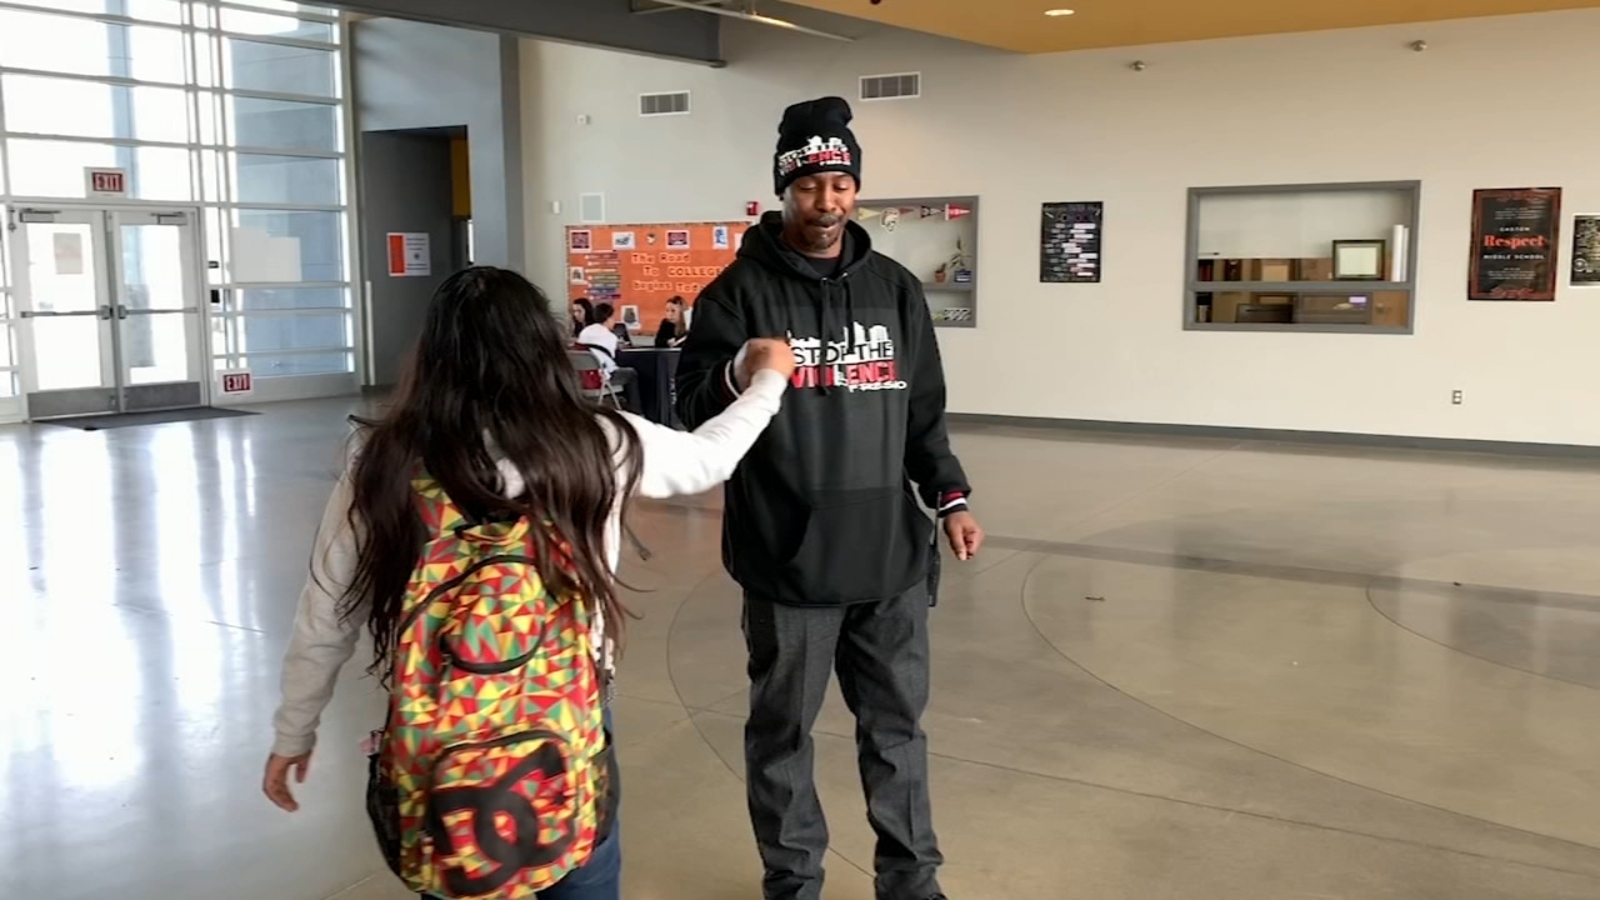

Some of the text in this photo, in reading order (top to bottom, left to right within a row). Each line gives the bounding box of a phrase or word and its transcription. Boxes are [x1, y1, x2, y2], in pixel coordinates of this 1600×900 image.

[95, 173, 122, 191] EXIT
[1483, 235, 1547, 249] Respect
[631, 252, 690, 264] The Road
[644, 266, 659, 276] To
[854, 341, 894, 361] THE
[225, 374, 249, 391] EXIT
